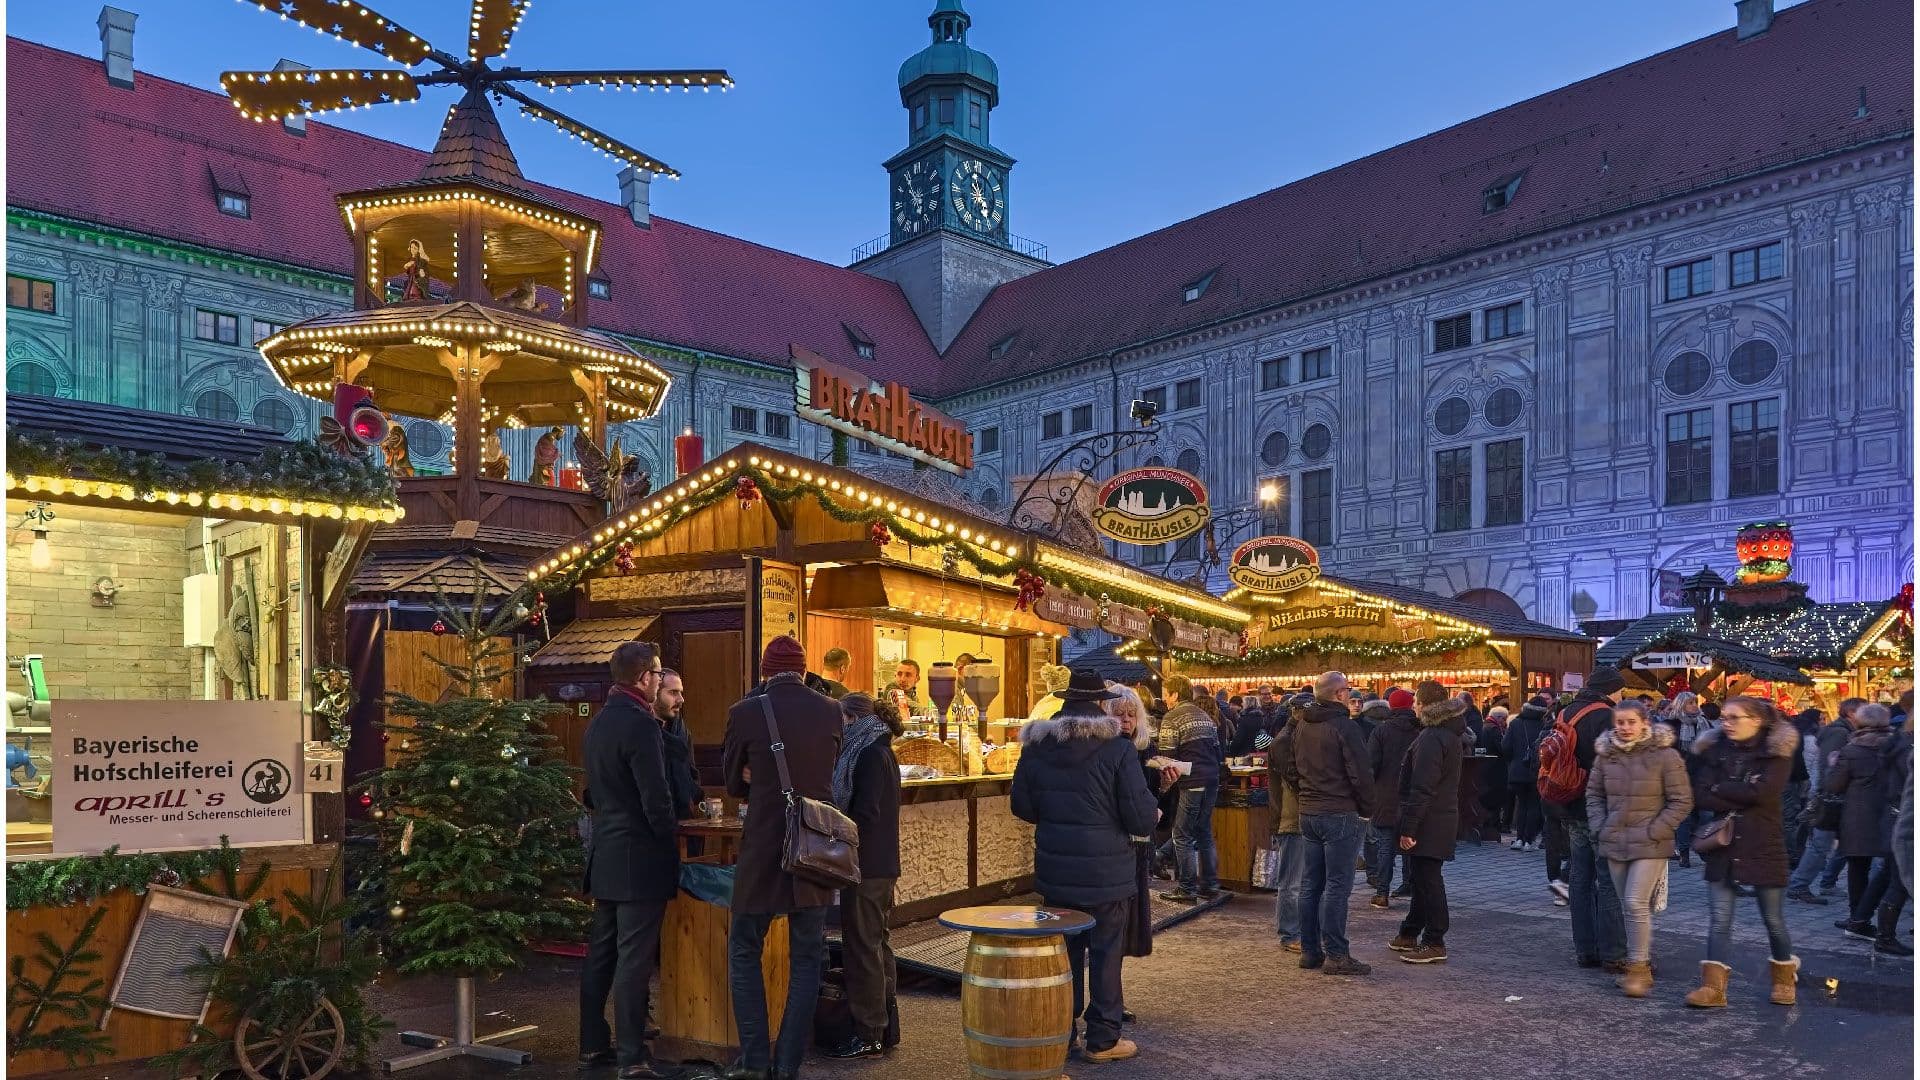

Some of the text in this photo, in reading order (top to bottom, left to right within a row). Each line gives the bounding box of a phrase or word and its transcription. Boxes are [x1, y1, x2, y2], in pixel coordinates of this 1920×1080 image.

[810, 368, 974, 469] BRATHÄUSLE
[1114, 471, 1149, 486] ORIGINAL
[1108, 517, 1193, 538] BRATHÄUSLE
[1242, 573, 1307, 589] BRATHÄUSLE
[1684, 654, 1709, 666] WC
[581, 704, 588, 714] G
[73, 736, 199, 758] Bayerische
[74, 761, 233, 782] Hofschleiferei
[310, 763, 333, 781] 41
[109, 806, 292, 825] Messer- und Scherenschleiferei
